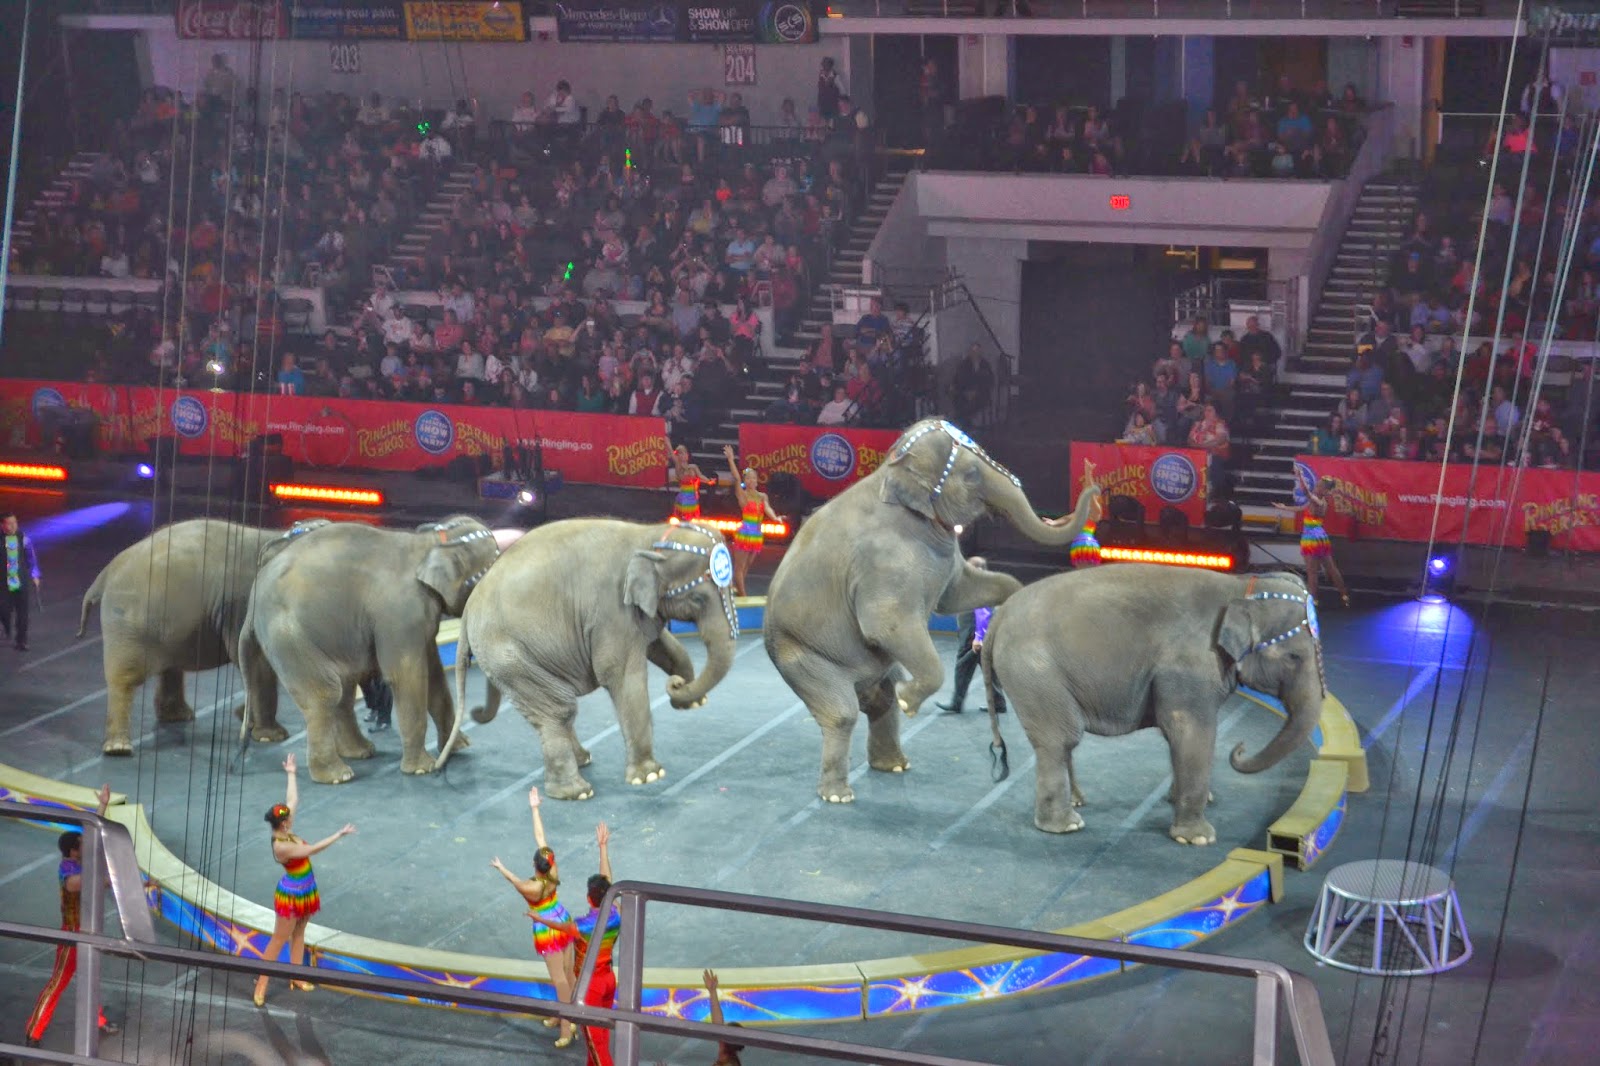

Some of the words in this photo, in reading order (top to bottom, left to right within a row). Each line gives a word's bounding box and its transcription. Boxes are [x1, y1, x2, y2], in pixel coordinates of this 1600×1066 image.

[687, 8, 720, 19] SHOW
[698, 19, 729, 30] SHOW
[331, 45, 358, 71] 203
[726, 55, 755, 82] 204
[606, 435, 665, 476] RINGLING
[816, 448, 850, 463] SHOW
[1156, 469, 1190, 485] SHOW
[1398, 493, 1507, 509] www.Rngling.com
